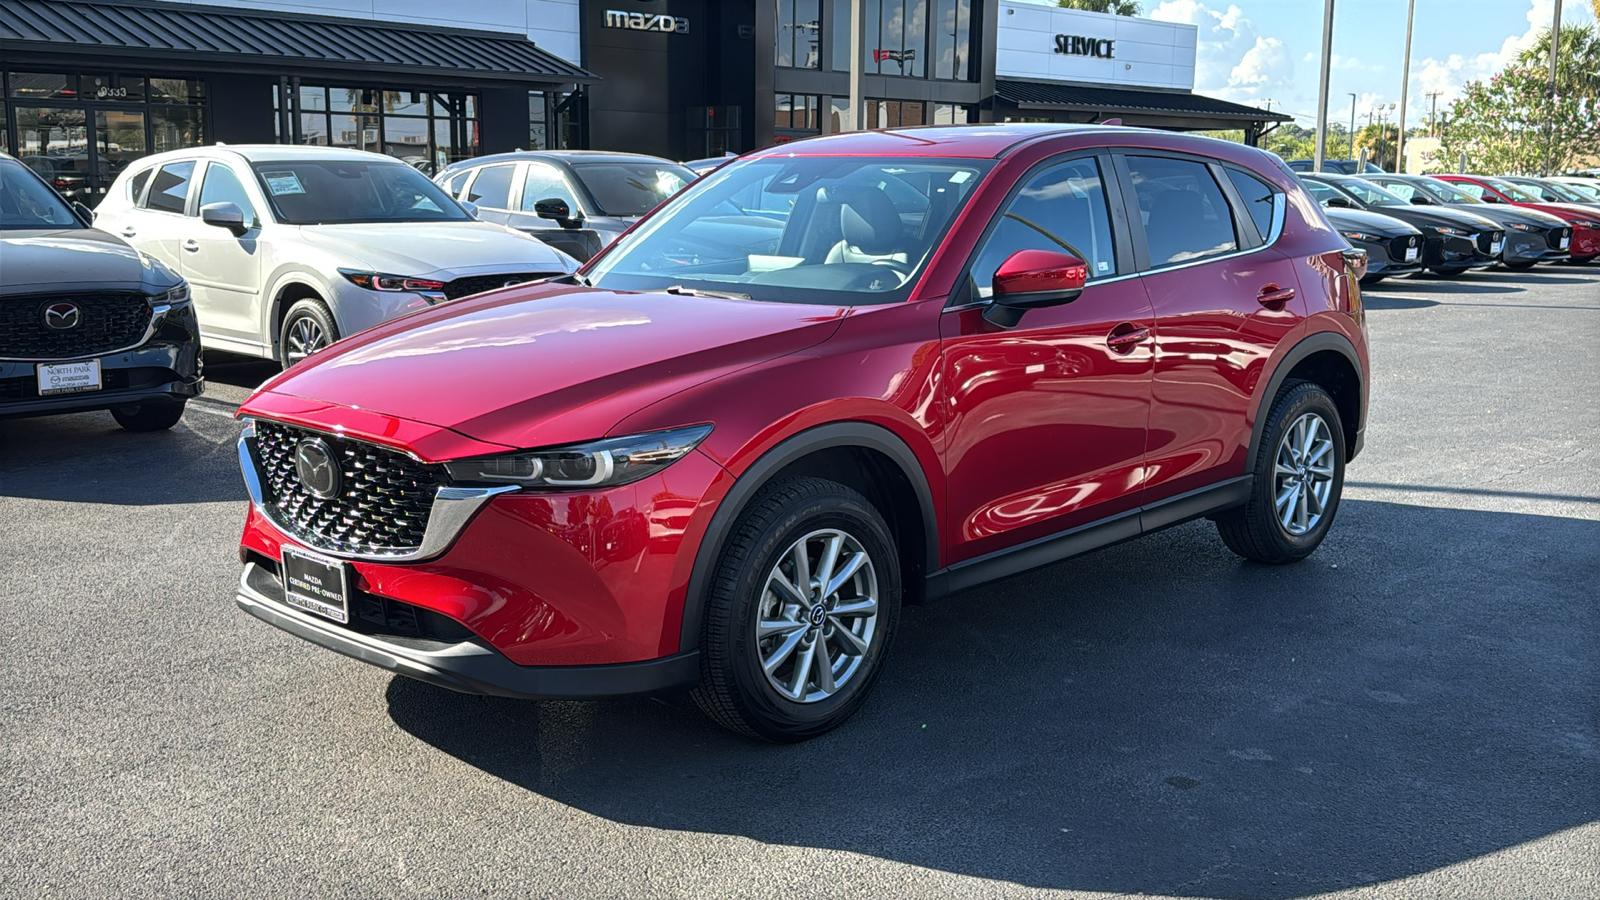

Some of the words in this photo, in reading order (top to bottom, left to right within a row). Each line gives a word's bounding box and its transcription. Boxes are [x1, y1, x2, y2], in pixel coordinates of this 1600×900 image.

[1054, 33, 1116, 59] SERVICE
[100, 86, 127, 97] 9333
[47, 367, 72, 375] NORTH
[303, 573, 322, 586] MAZDA
[289, 576, 311, 591] CERTIFIED
[311, 585, 343, 602] PRE-OWNED
[307, 600, 319, 612] PARK
